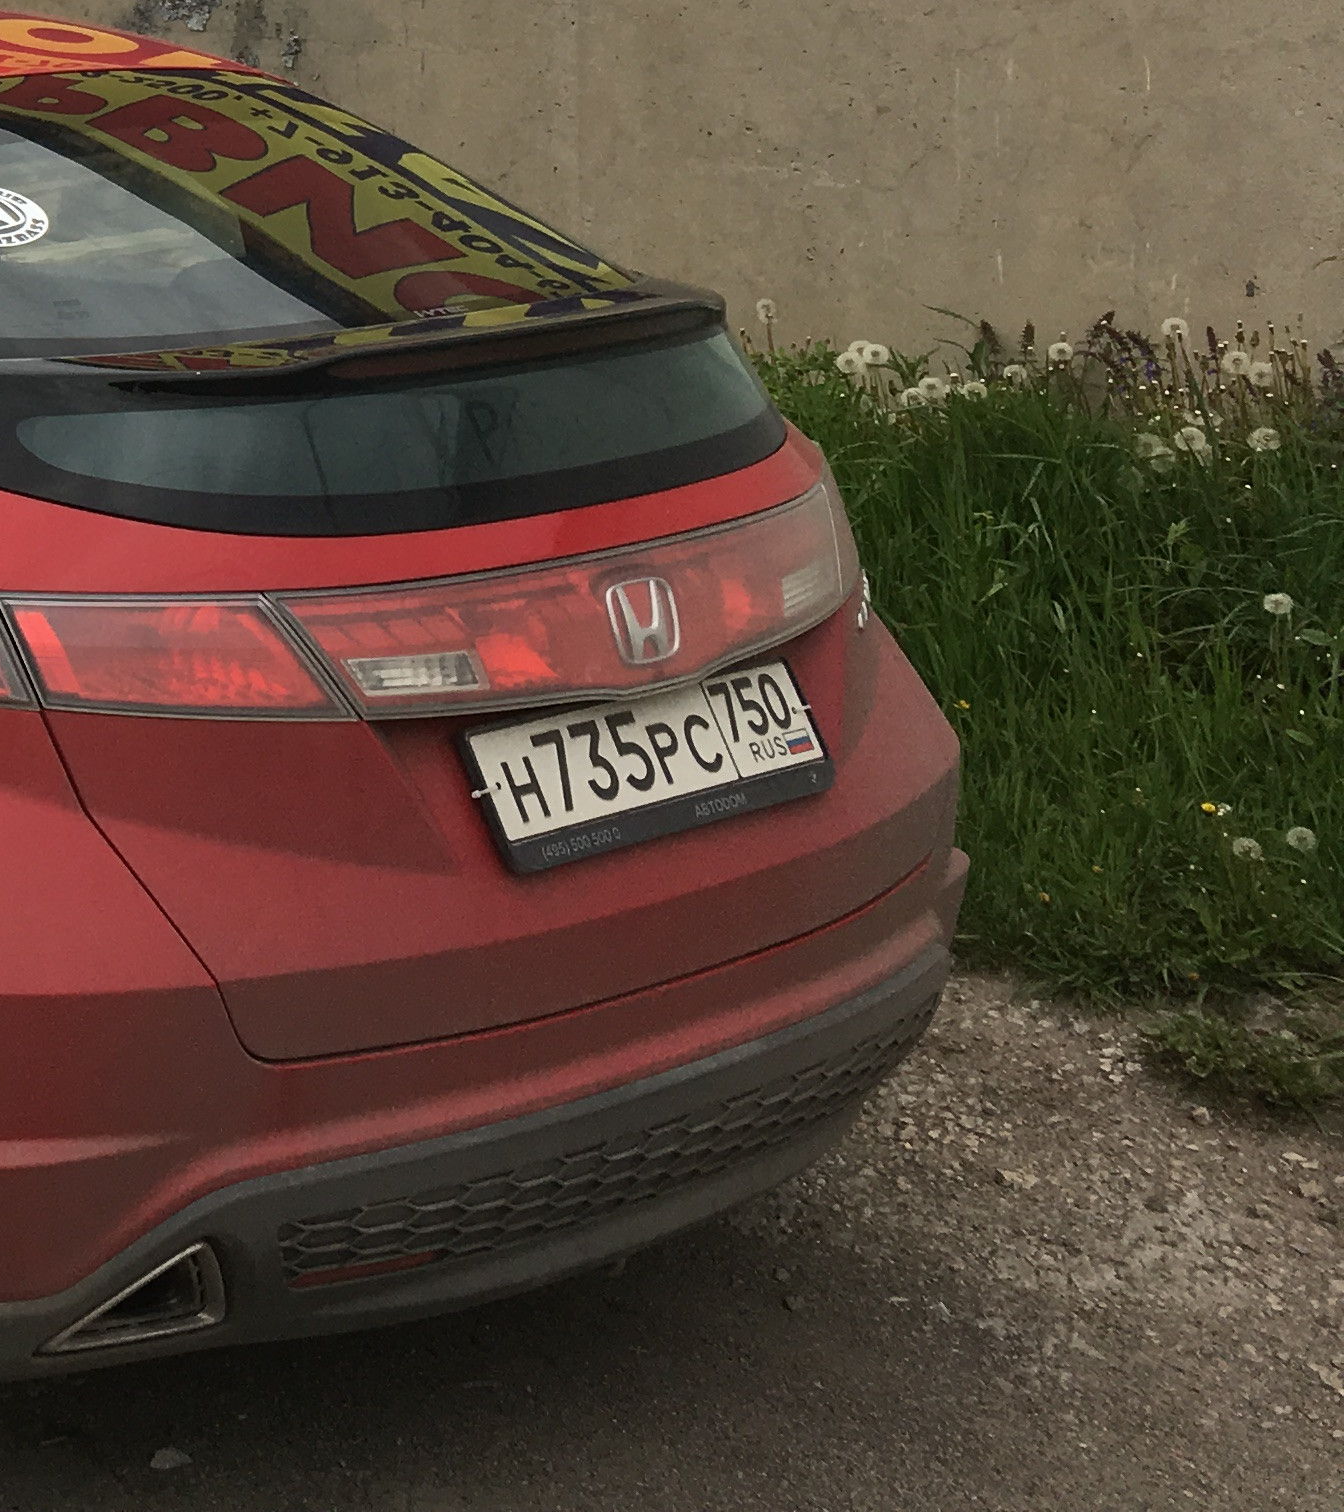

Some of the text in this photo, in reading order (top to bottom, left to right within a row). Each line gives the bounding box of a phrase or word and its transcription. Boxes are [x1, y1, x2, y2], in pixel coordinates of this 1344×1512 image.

[500, 673, 792, 823] Н735РС 750
[749, 735, 788, 763] RUS
